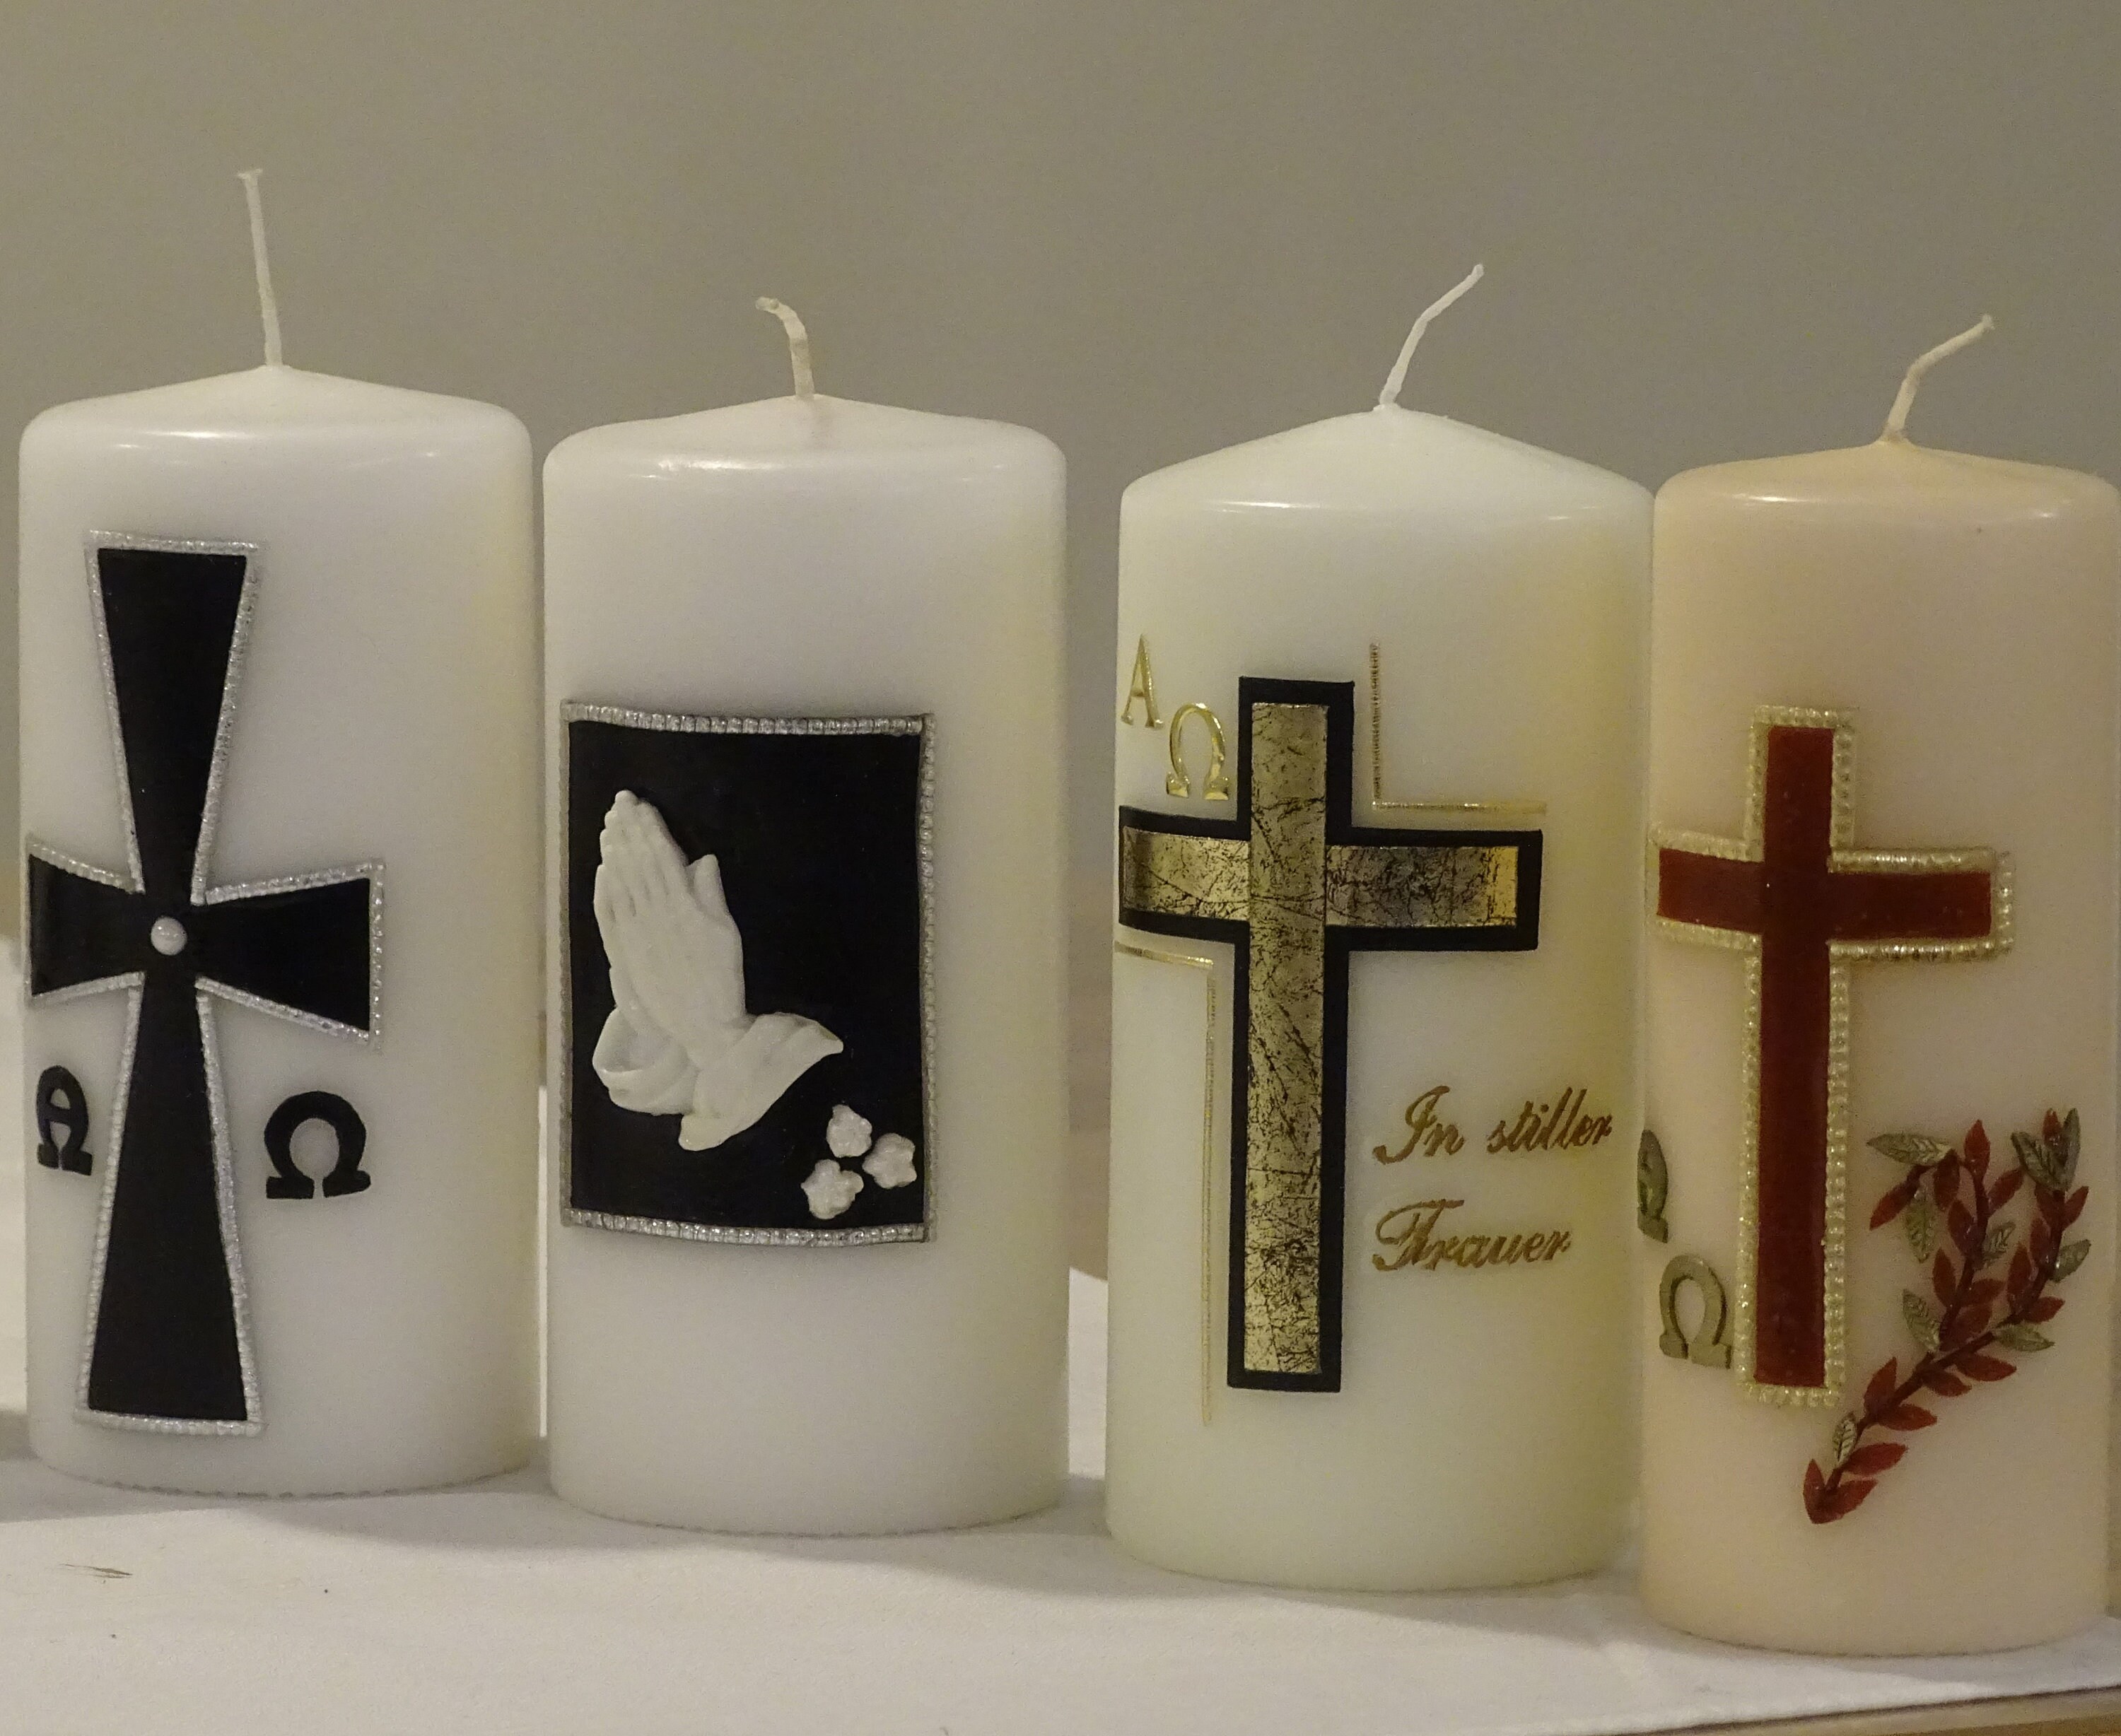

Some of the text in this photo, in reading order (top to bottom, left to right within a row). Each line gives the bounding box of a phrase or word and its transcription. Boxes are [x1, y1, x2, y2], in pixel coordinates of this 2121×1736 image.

[1121, 634, 1164, 729] A
[1372, 1085, 1613, 1165] In stiller
[1372, 1199, 1571, 1272] Trauer
